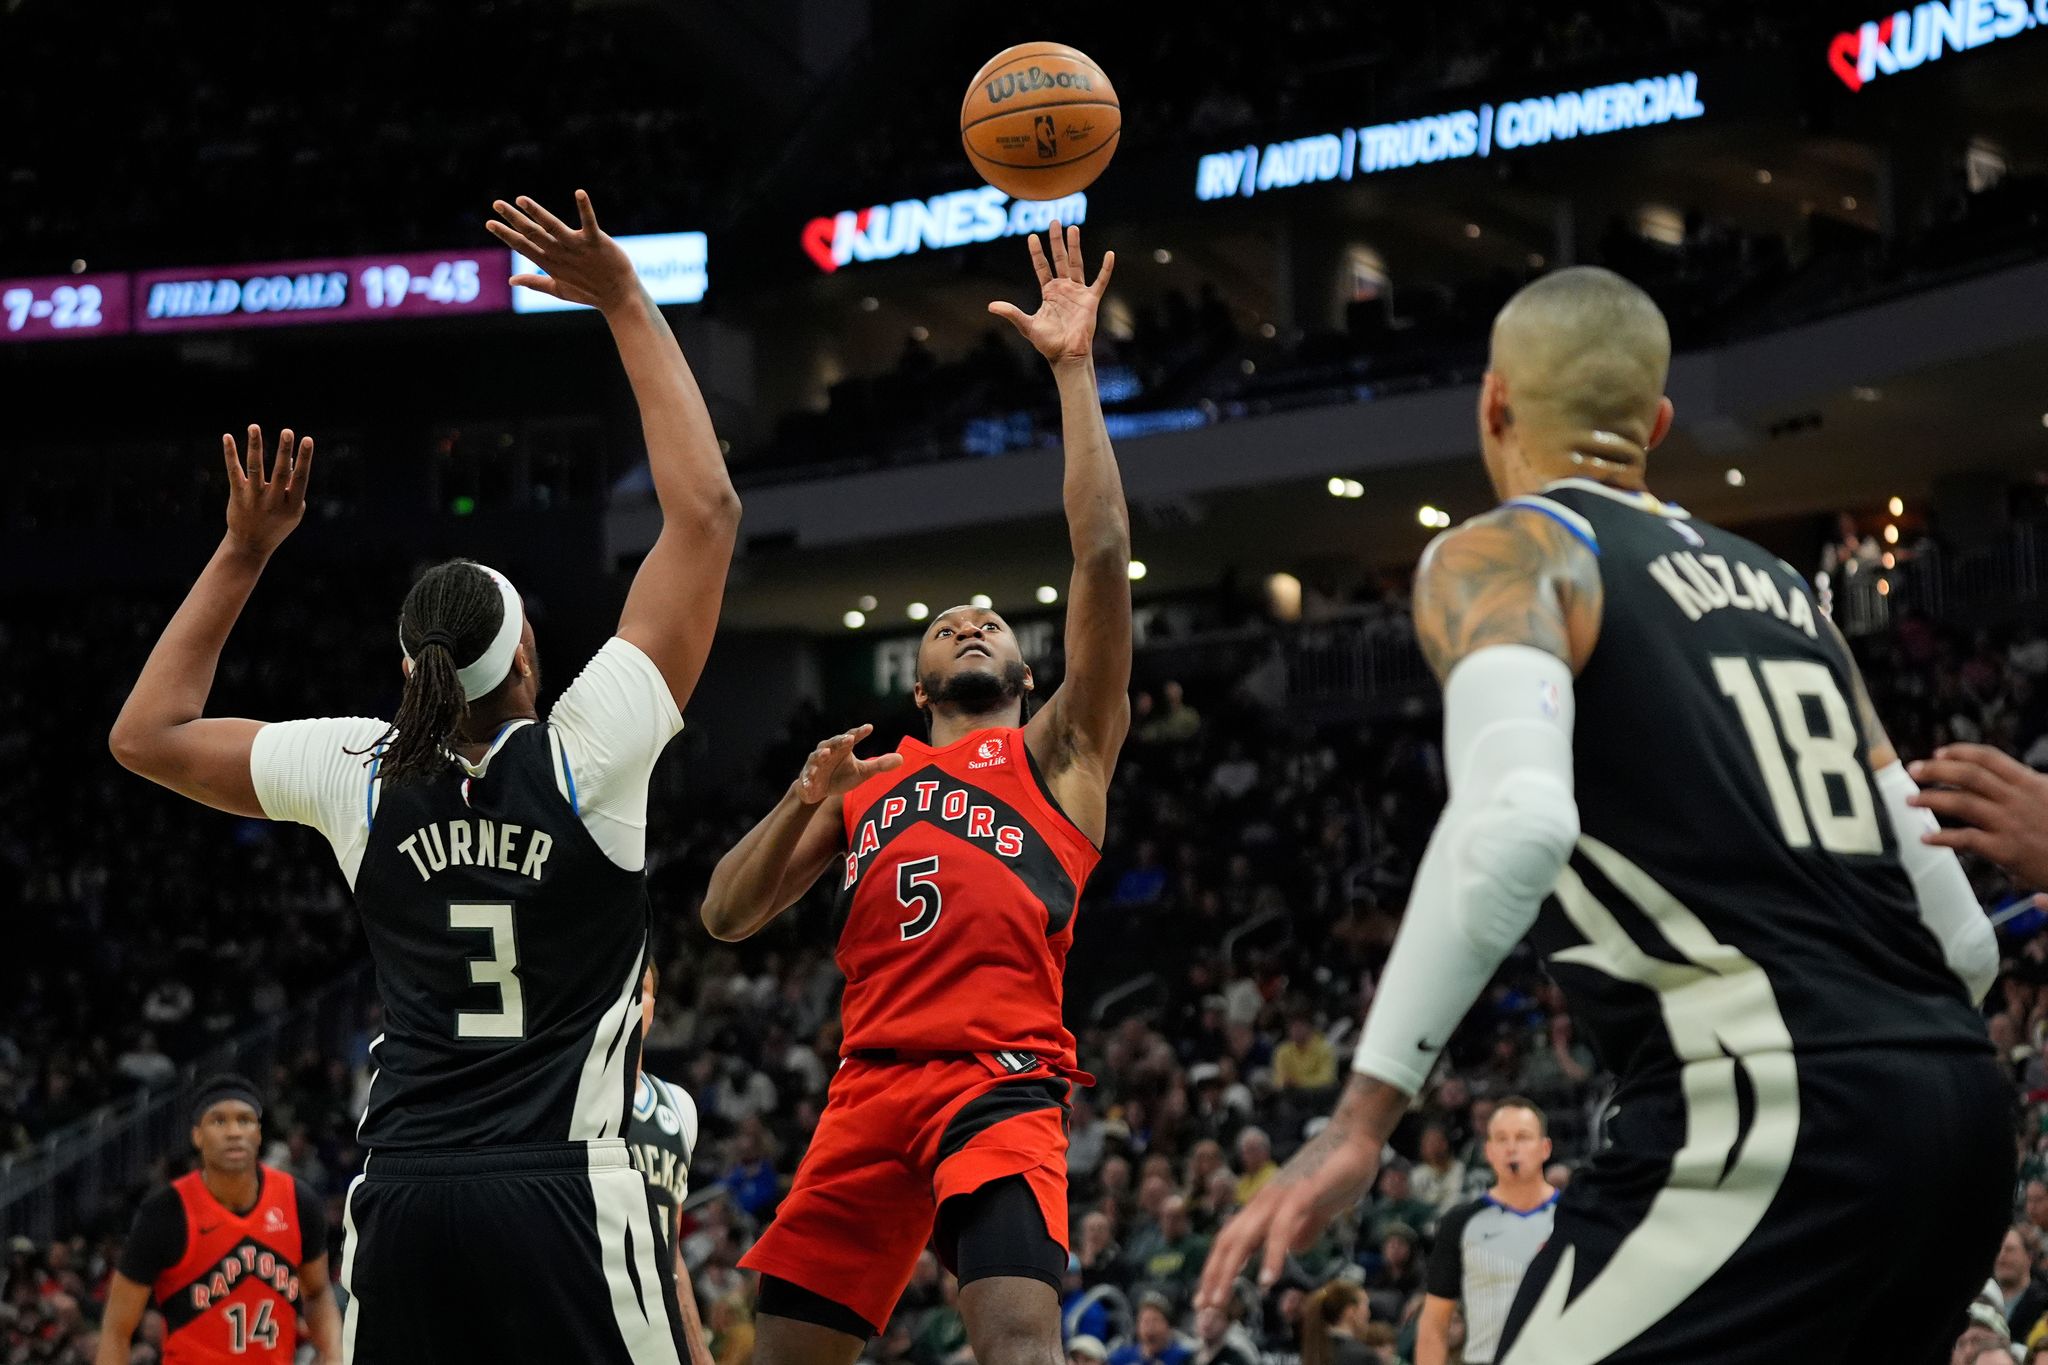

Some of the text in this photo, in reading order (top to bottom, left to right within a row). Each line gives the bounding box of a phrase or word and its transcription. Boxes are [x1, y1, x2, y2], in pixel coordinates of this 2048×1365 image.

[985, 66, 1091, 103] Wilson
[1196, 70, 1705, 200] RV AUTO TRUCKS COMMERCIAL
[831, 184, 1087, 266] KUNES.com
[2, 284, 102, 331] 7-22
[241, 271, 348, 313] GOALS
[360, 258, 481, 309] 19-45
[1648, 551, 1818, 639] KUZMA
[968, 757, 1006, 769] Sun Life
[1710, 656, 1884, 857] 18
[397, 819, 553, 882] TURNER
[844, 780, 1024, 891] RAPTORS
[896, 855, 942, 941] 5
[449, 903, 524, 1038] 3
[192, 1245, 299, 1311] RAPTORS
[223, 1299, 279, 1353] 14
